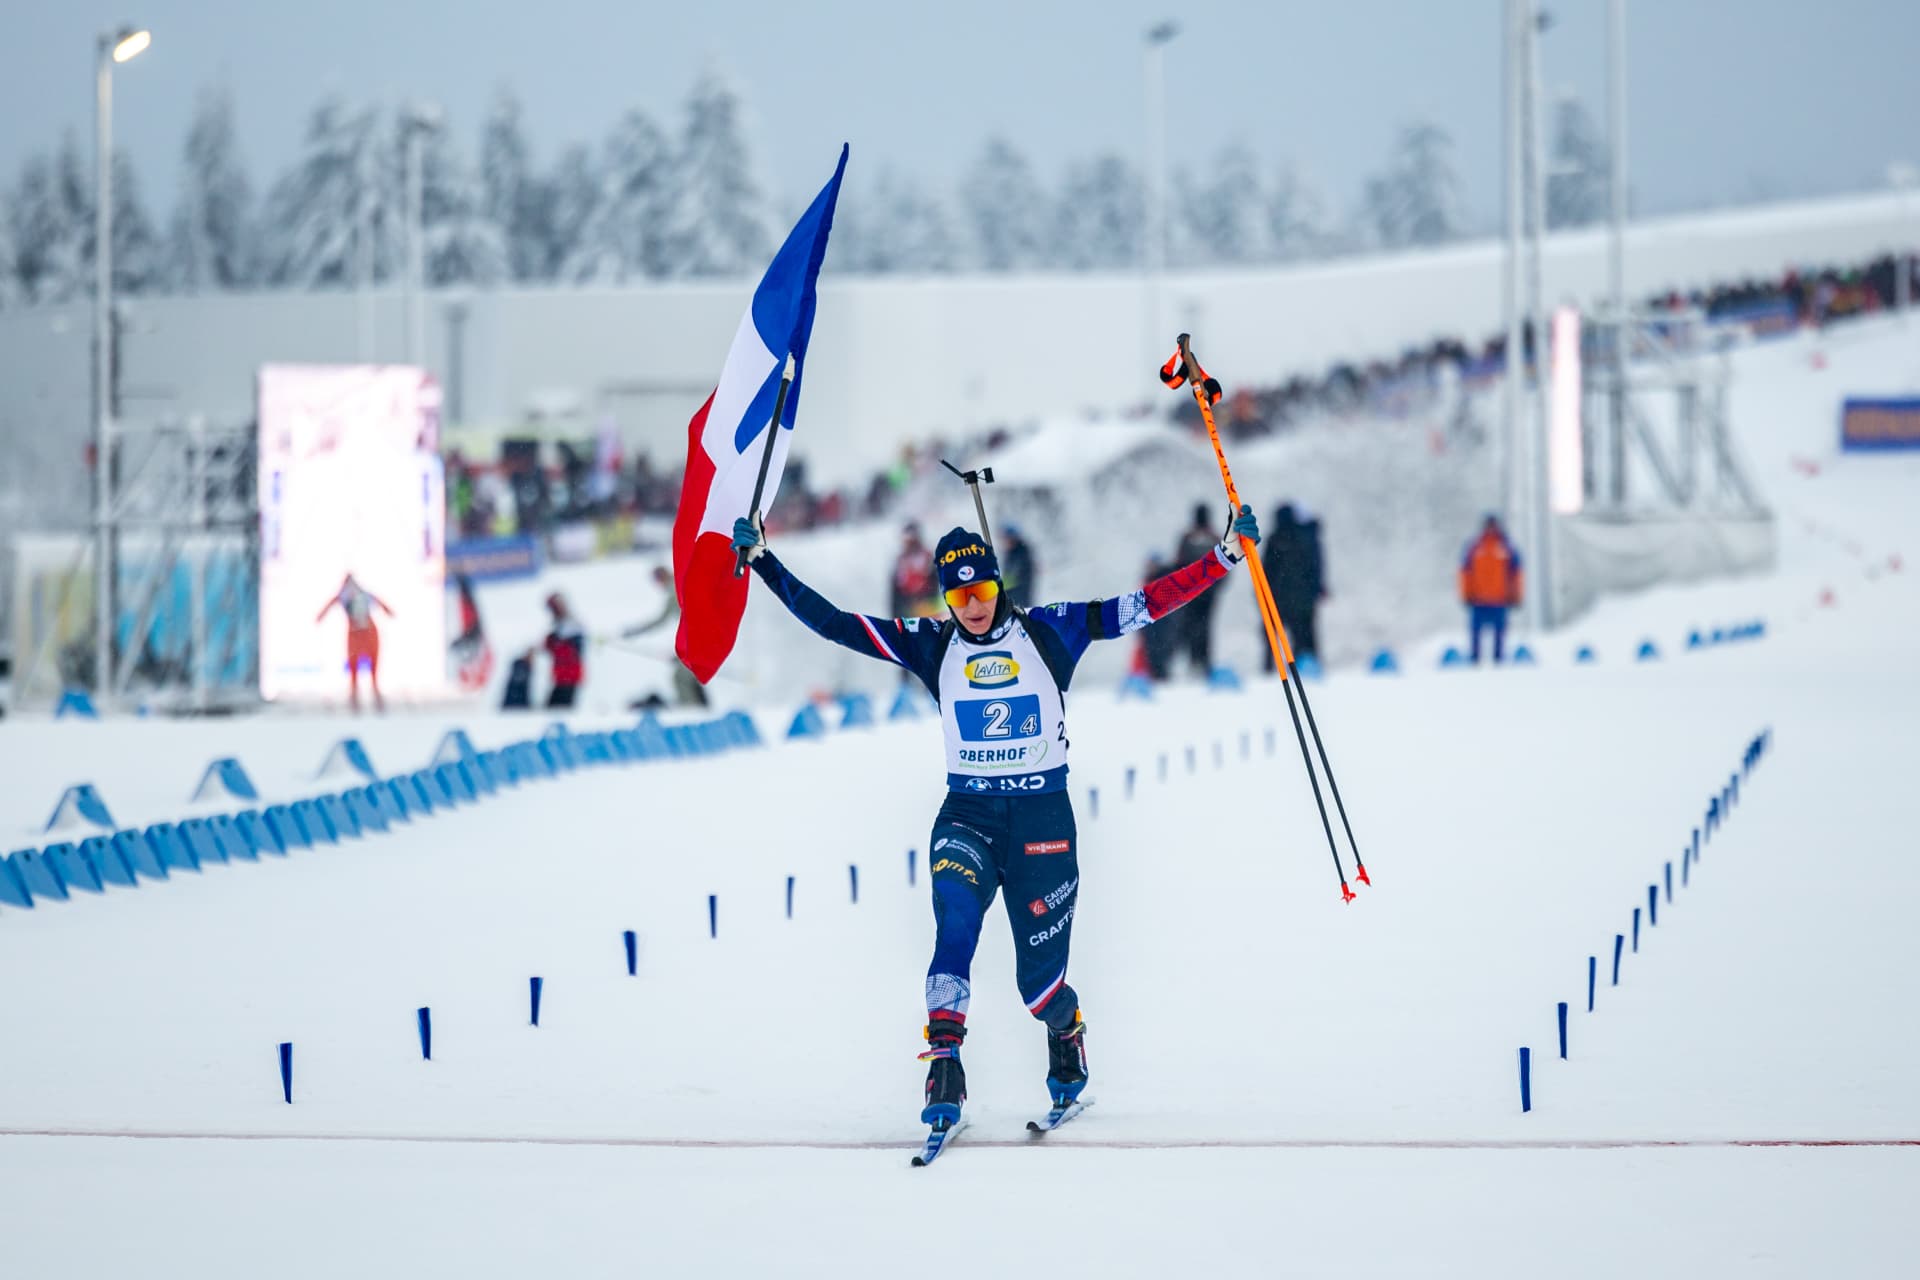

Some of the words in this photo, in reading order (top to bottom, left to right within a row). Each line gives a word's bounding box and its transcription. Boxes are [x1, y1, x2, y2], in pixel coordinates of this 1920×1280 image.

[939, 543, 986, 567] somfy
[983, 700, 1012, 738] 2
[1020, 714, 1037, 735] 4
[1029, 911, 1070, 947] CRAFT
